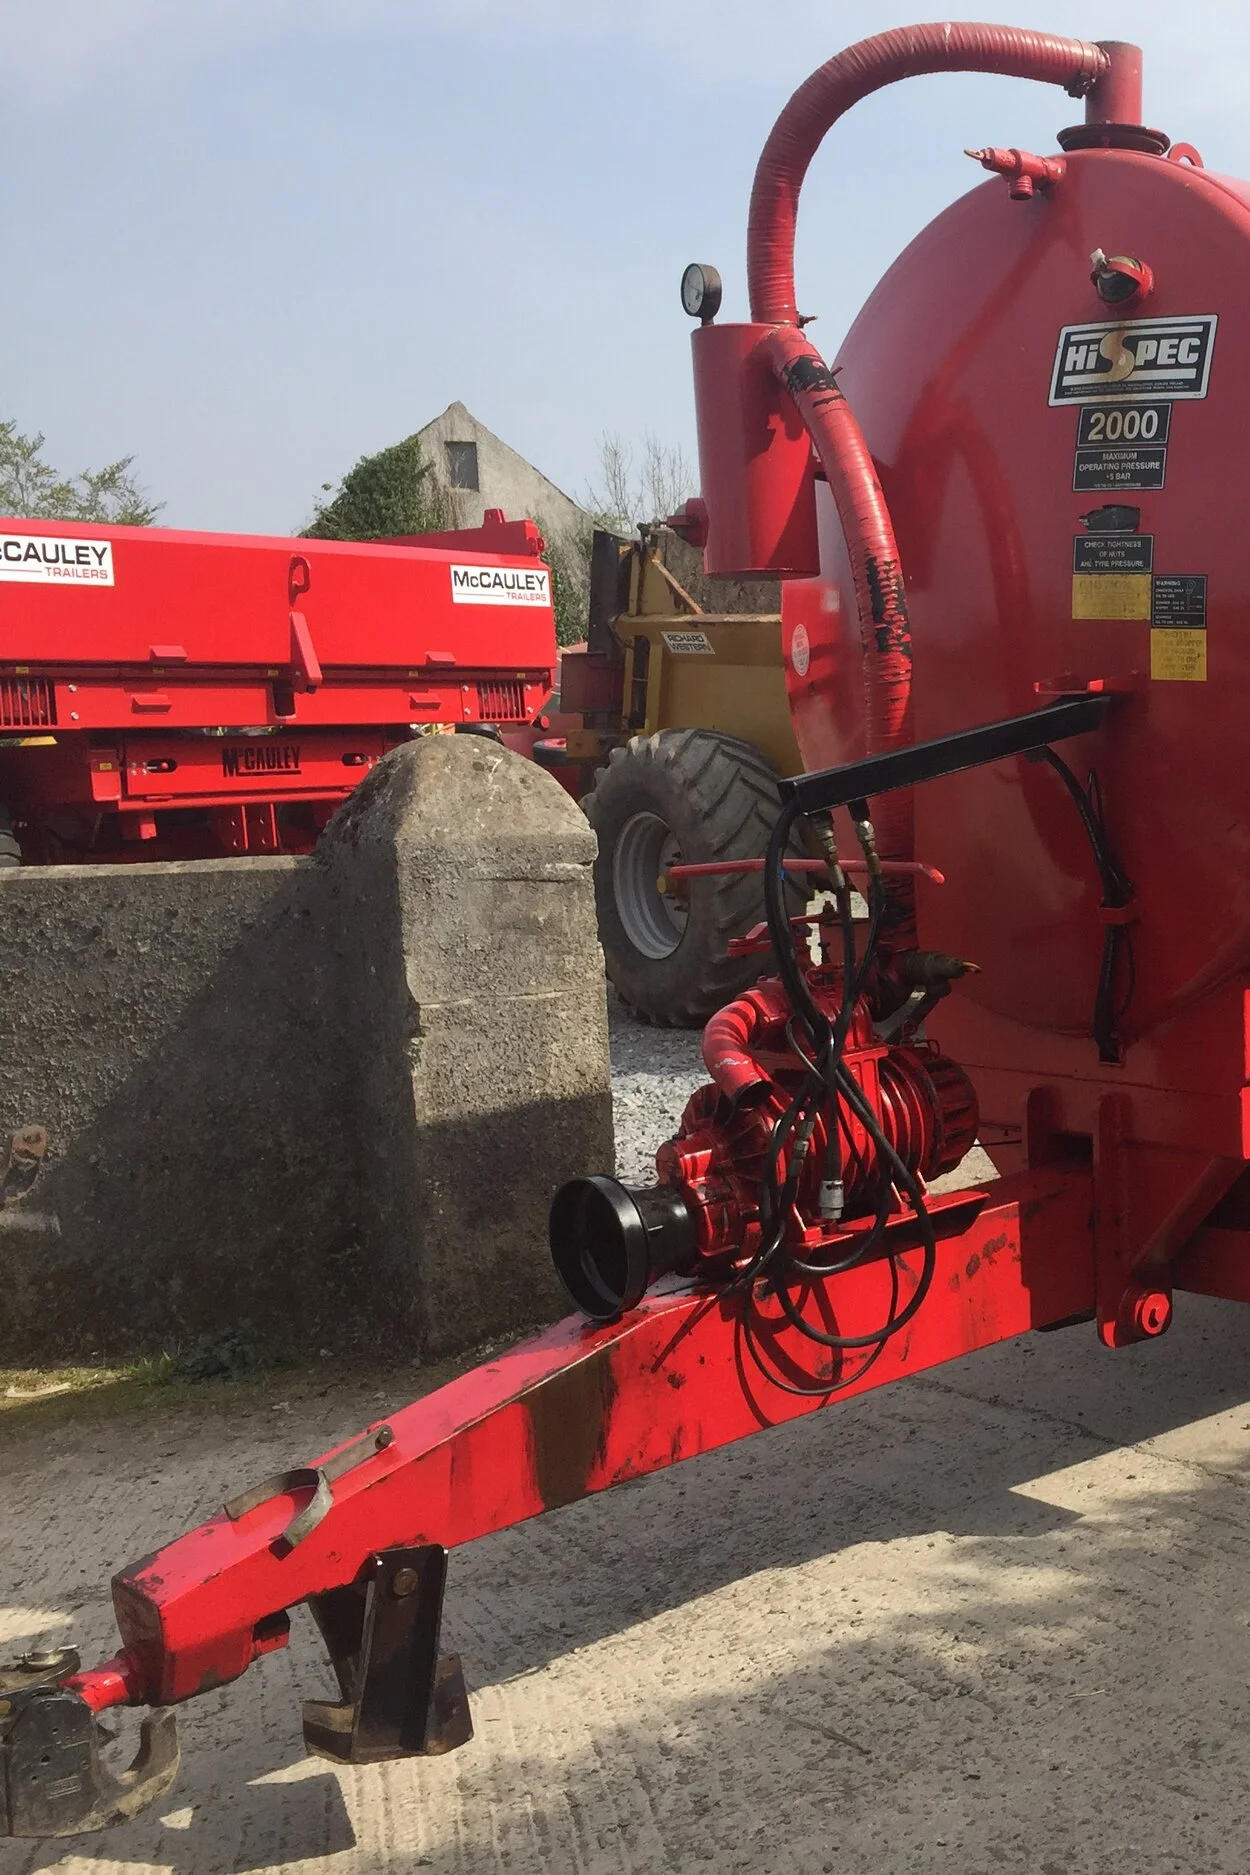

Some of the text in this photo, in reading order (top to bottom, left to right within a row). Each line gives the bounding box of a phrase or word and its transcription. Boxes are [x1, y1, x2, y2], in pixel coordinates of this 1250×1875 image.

[1087, 410, 1159, 441] 2000
[1102, 452, 1138, 461] MAXIMUM
[1079, 461, 1161, 472] OPERATING PRESSURE
[1115, 472, 1131, 480] BAR
[1107, 540, 1142, 548] TIGHTNESS
[0, 540, 107, 566] CAULEY
[45, 567, 108, 579] TRAILERS
[453, 570, 546, 591] McCAULEY
[506, 592, 547, 602] TRAILERS
